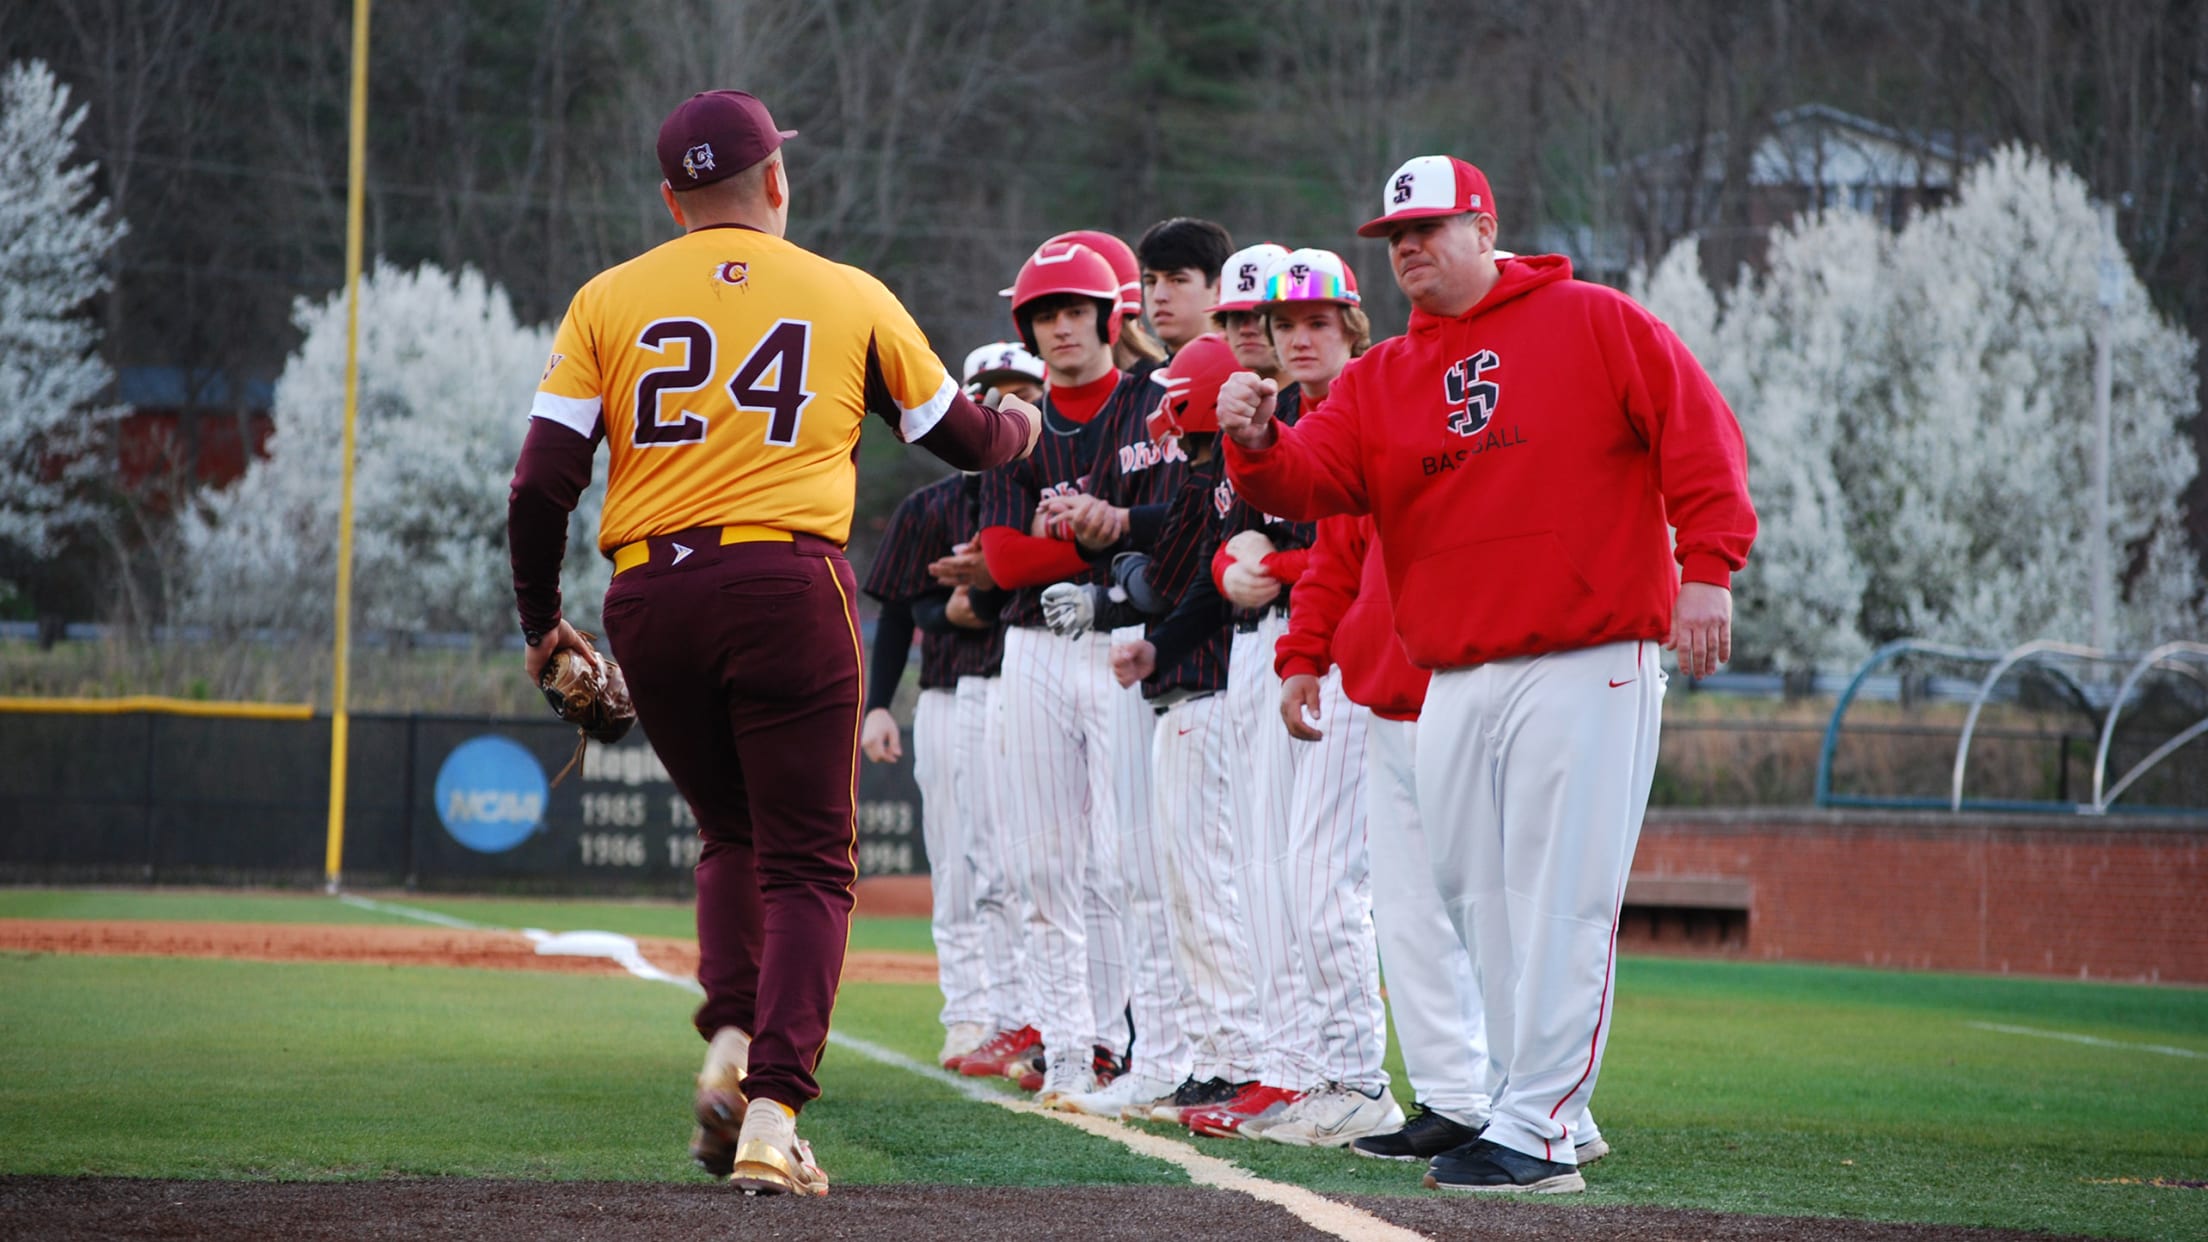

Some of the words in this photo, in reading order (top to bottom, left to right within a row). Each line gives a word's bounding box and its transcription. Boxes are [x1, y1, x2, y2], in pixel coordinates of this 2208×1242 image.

[632, 317, 817, 448] 24
[1422, 425, 1527, 476] BASALL
[580, 833, 646, 867] 1986
